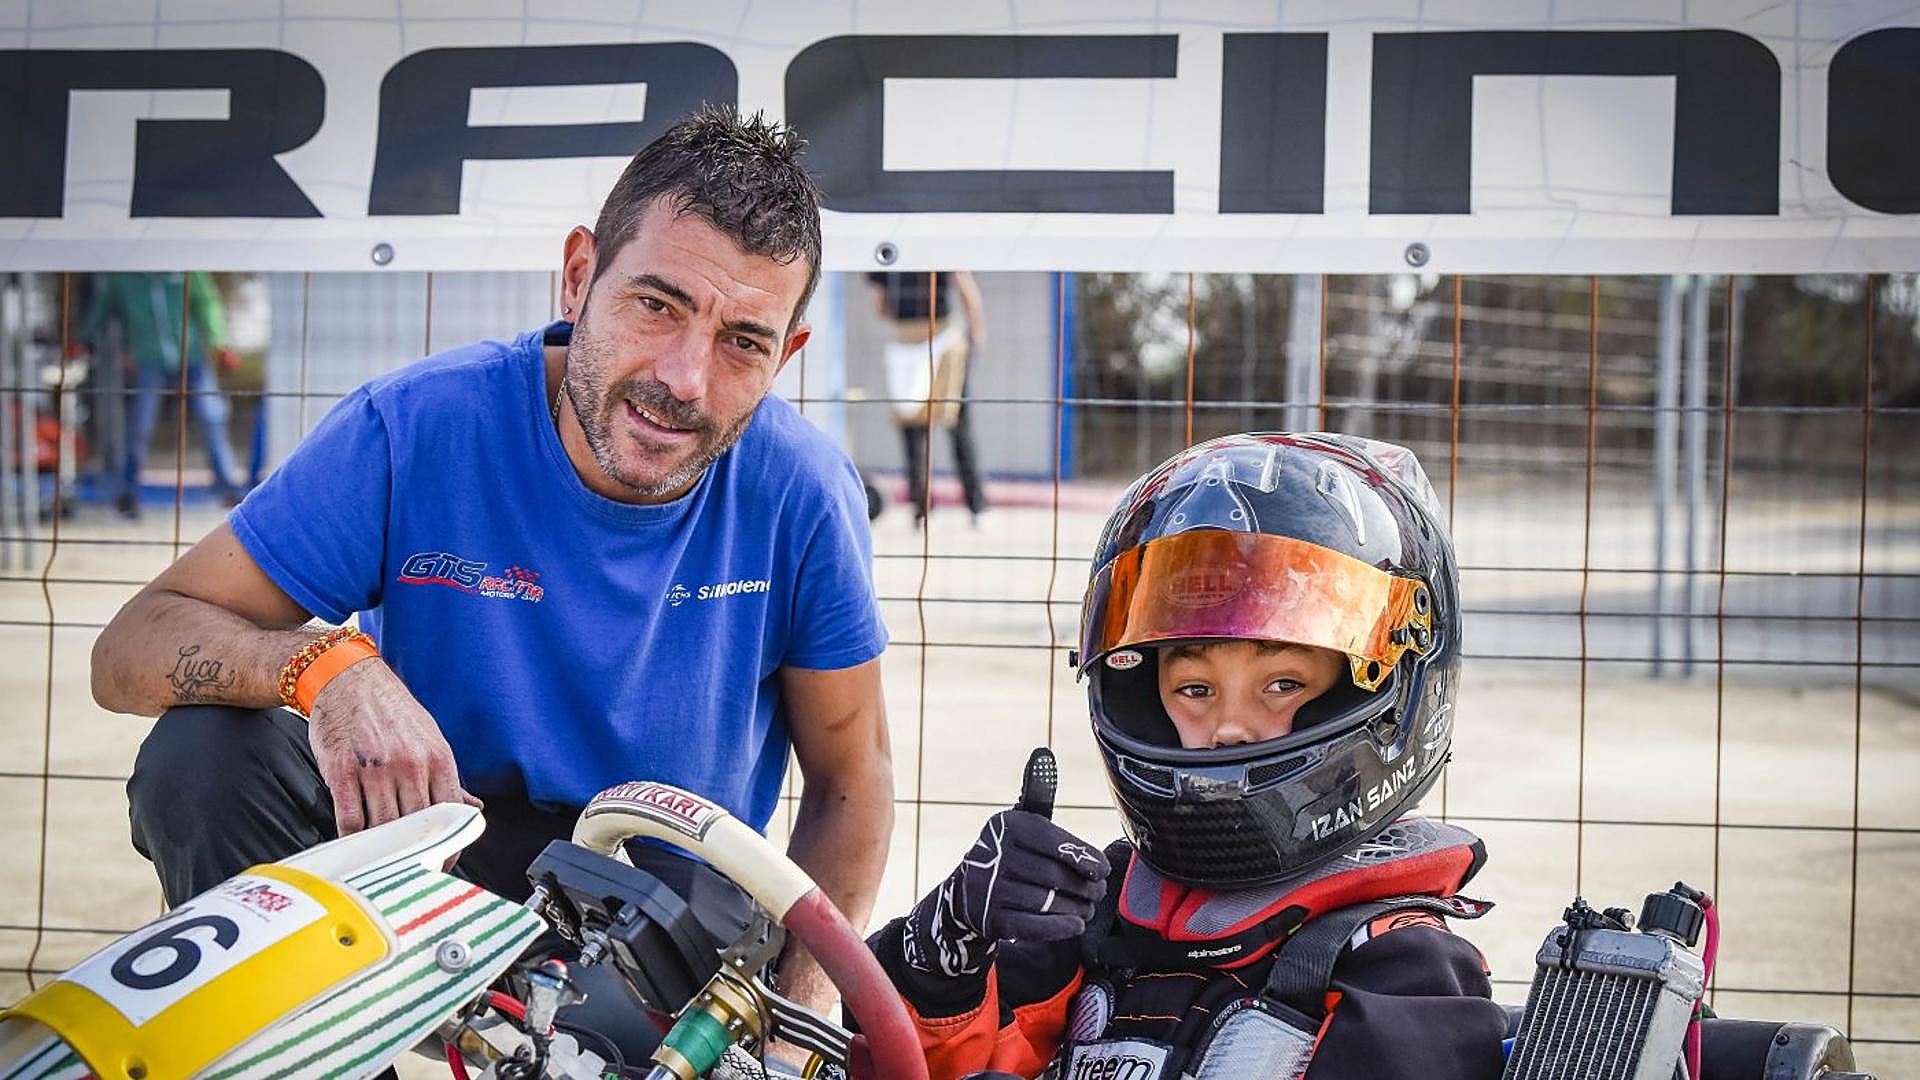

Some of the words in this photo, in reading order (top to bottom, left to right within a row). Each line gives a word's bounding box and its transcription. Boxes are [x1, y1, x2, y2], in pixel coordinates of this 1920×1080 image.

[0, 27, 1920, 218] RACIN
[400, 552, 488, 588] GTS
[166, 645, 220, 679] Luca
[1110, 654, 1138, 665] BELL
[643, 786, 703, 818] KART
[1311, 797, 1363, 841] IZAN
[1366, 755, 1416, 811] SAINZ
[1073, 1049, 1156, 1080] freem
